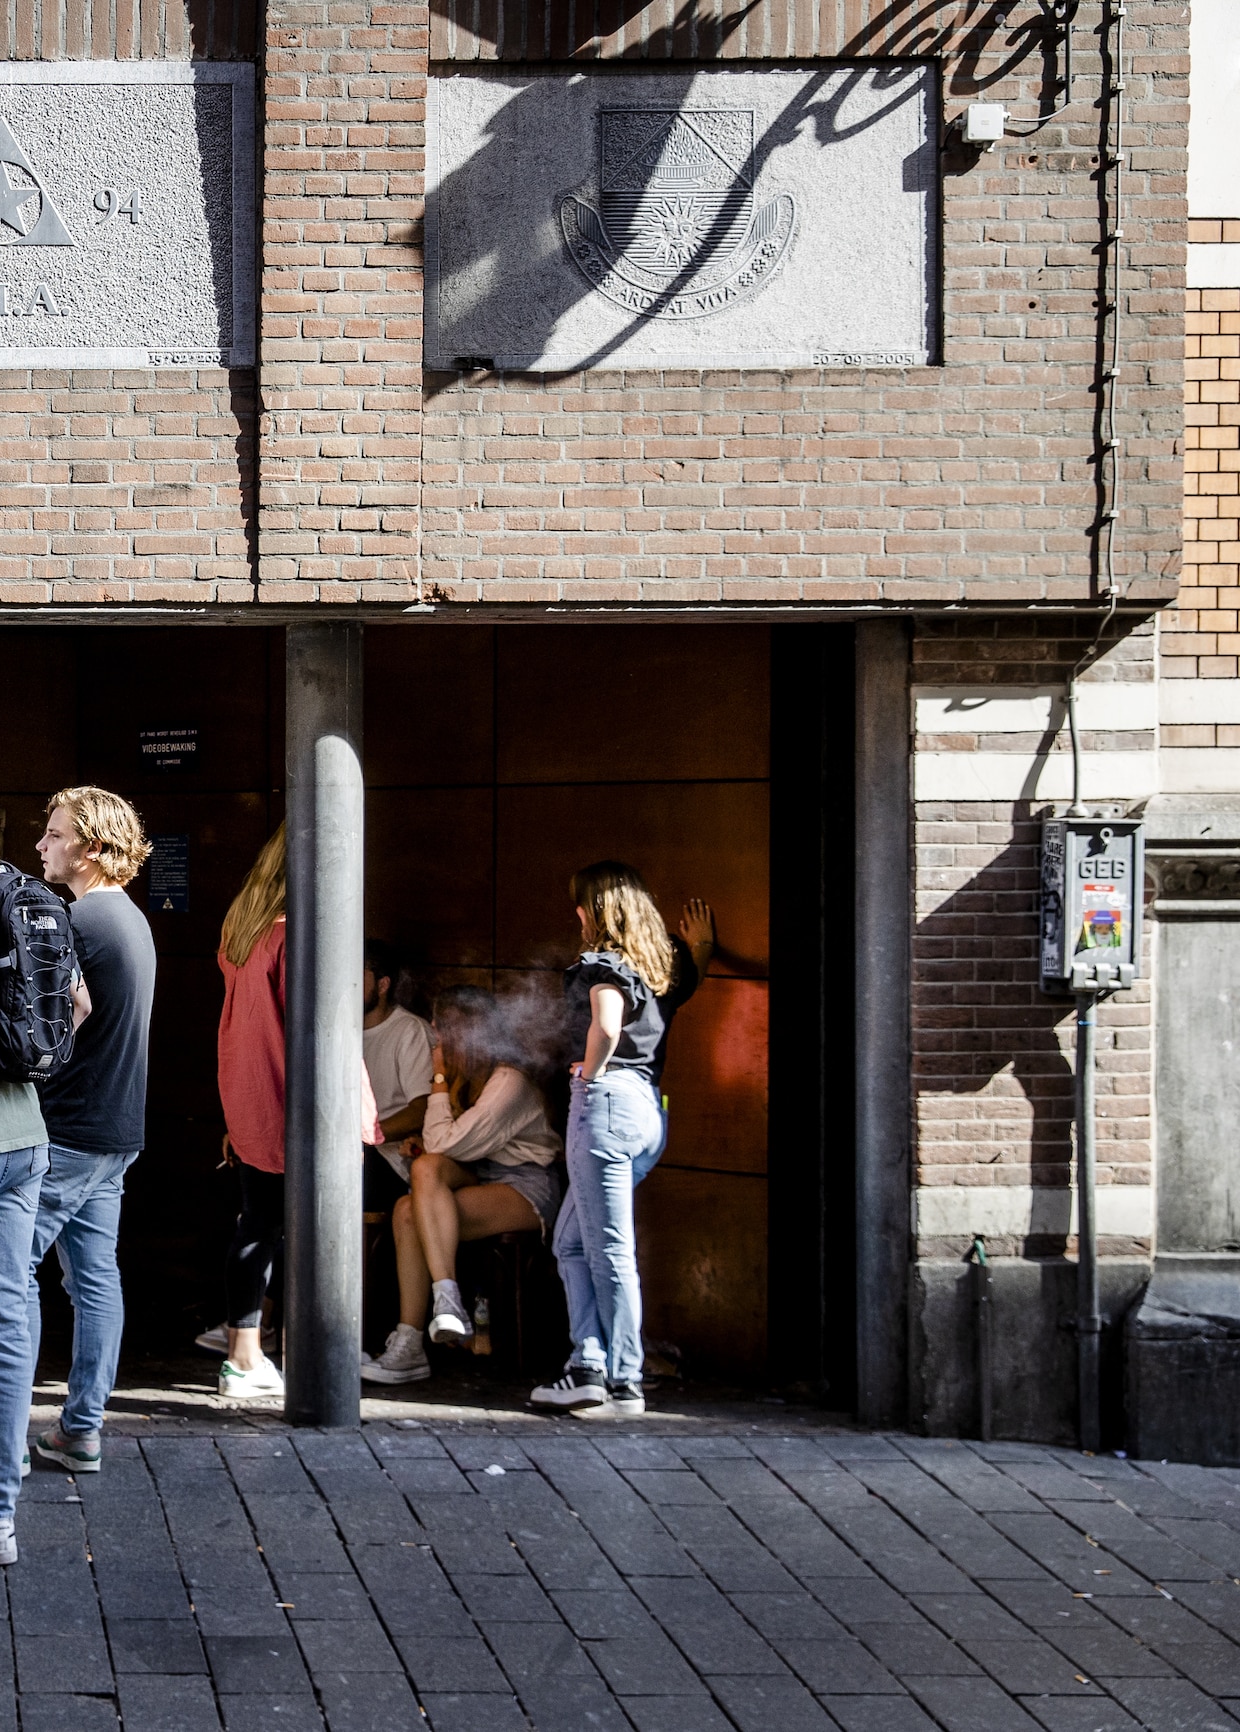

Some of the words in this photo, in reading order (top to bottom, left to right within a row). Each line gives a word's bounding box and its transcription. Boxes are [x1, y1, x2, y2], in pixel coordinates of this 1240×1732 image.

[94, 189, 143, 224] 94
[620, 285, 687, 314] ARDEAT
[696, 286, 737, 310] VITA
[142, 742, 196, 753] VIDEOBEWAKING
[1078, 858, 1127, 879] GEB
